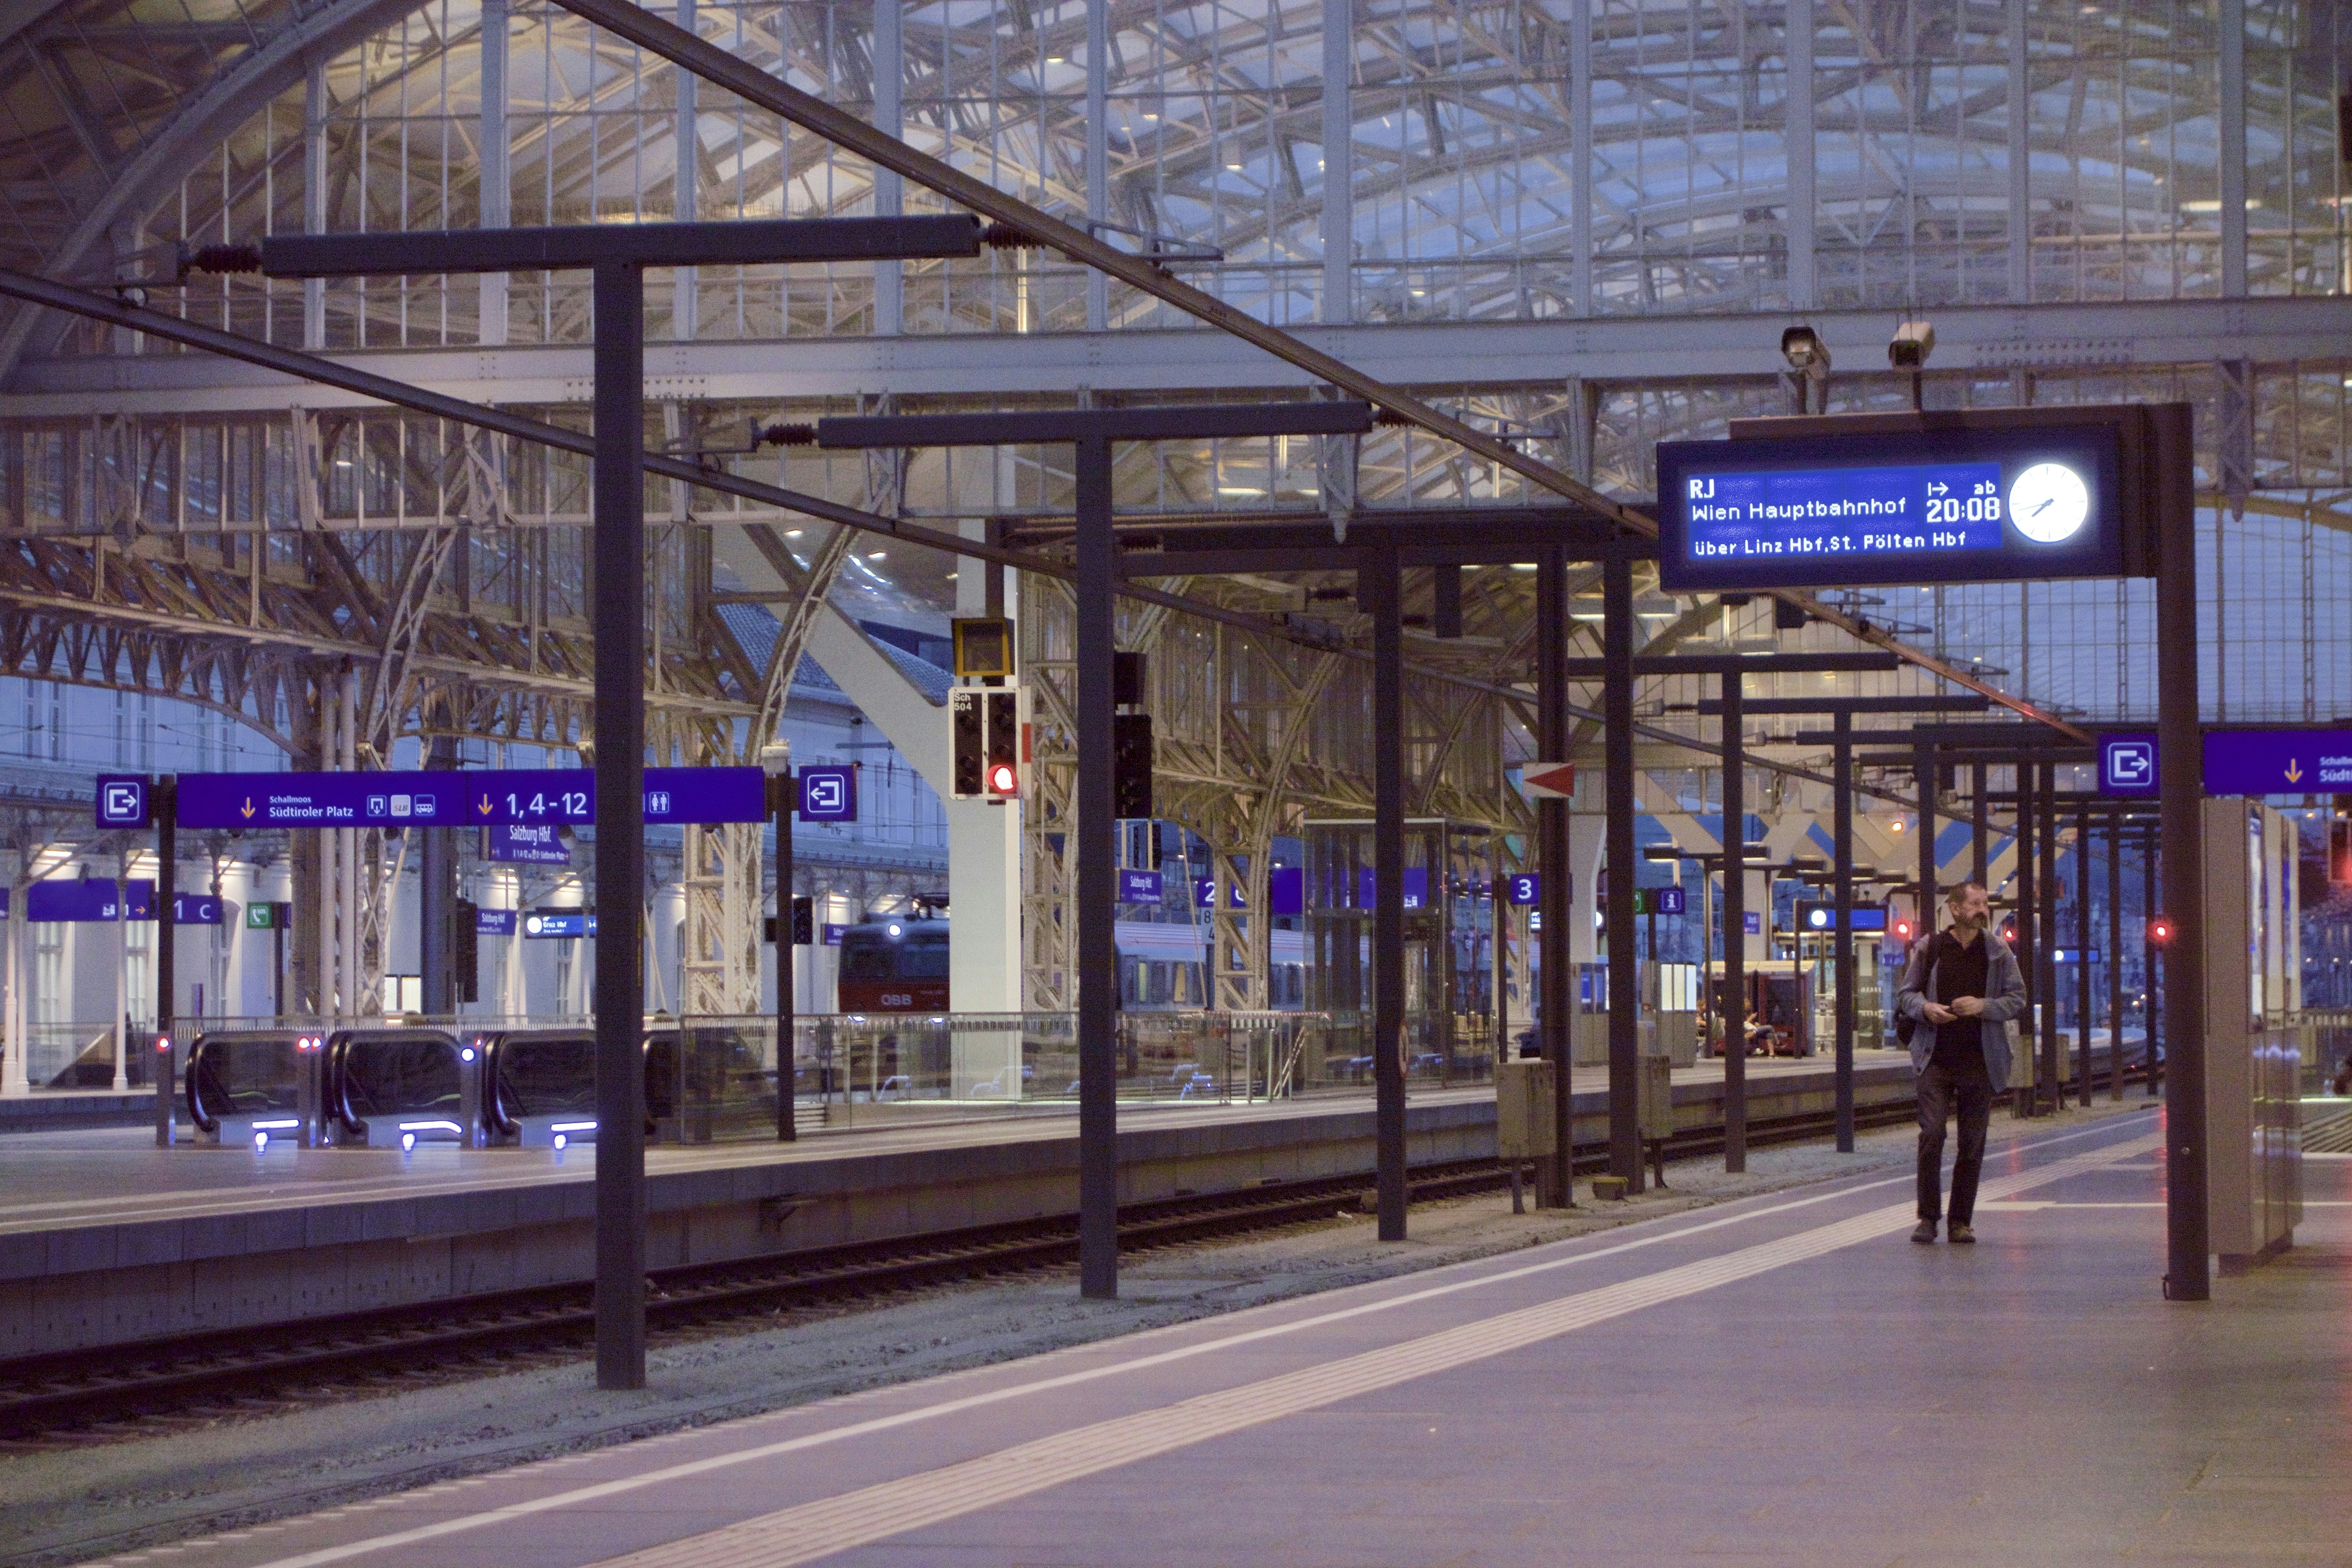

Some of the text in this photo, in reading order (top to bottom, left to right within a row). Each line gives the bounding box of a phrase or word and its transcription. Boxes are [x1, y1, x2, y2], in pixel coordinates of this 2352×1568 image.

[1690, 479, 1715, 499] RJ
[1974, 480, 1996, 495] ab
[1693, 497, 1906, 521] Wien Hauptbahnhof
[1926, 497, 2000, 523] 20:08
[1695, 541, 1737, 555] über
[1745, 539, 1782, 554] Linz
[1864, 533, 1925, 549] Pölten
[1933, 531, 1966, 547] Hbf
[954, 693, 971, 701] Sch
[954, 702, 972, 711] 504
[270, 795, 311, 803] Schallmoos
[270, 806, 353, 817] Südtiroler Platz
[510, 825, 537, 846] Salzburg
[1205, 882, 1214, 901] 2
[1518, 879, 1532, 899] 3
[174, 900, 182, 919] 1
